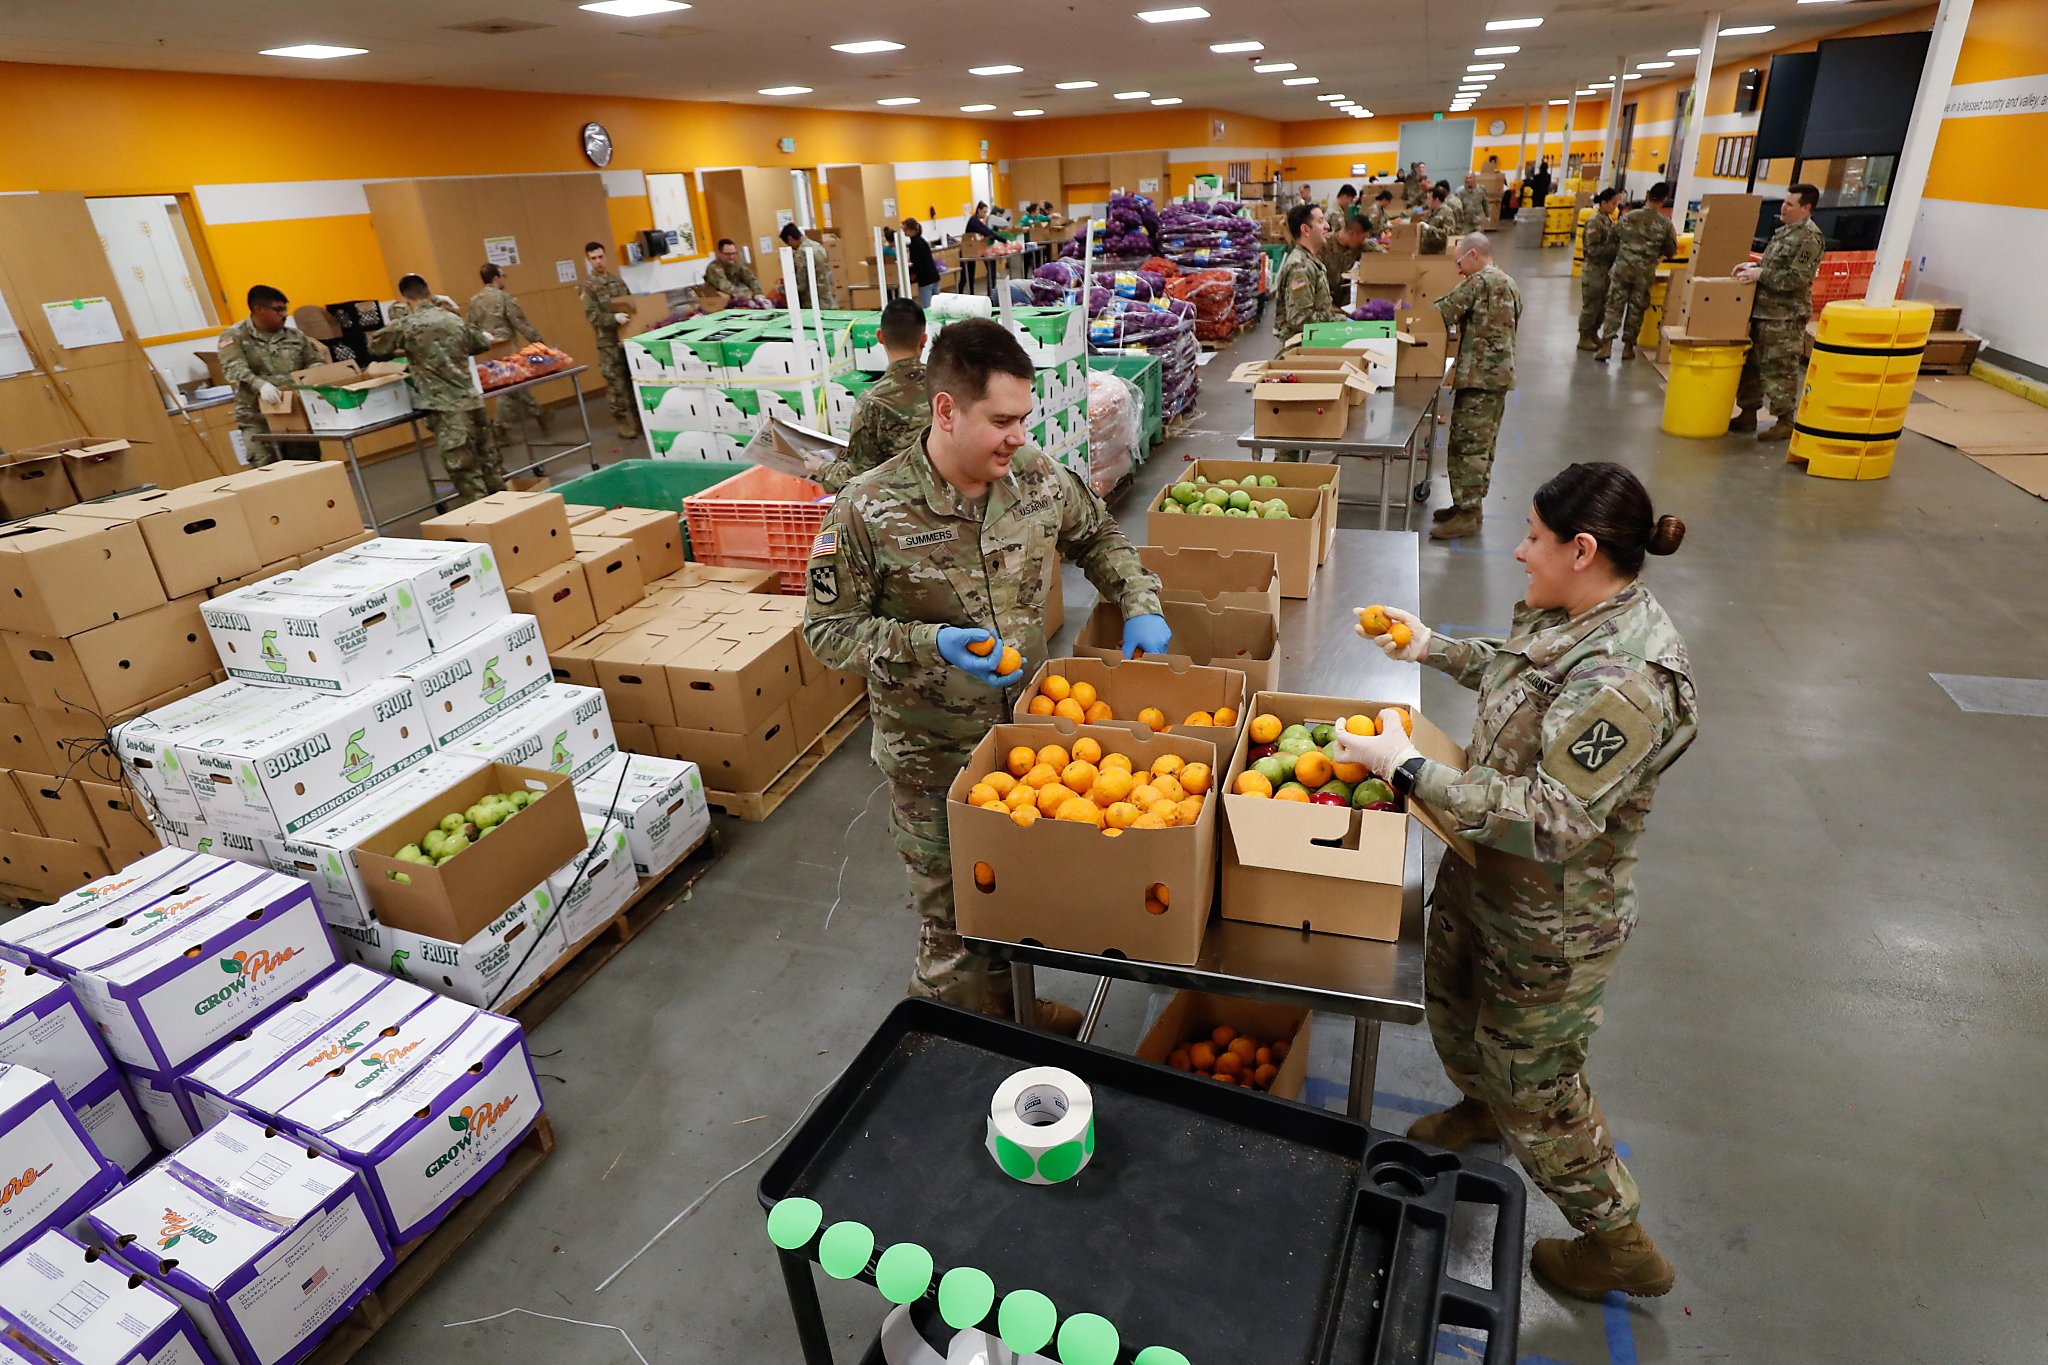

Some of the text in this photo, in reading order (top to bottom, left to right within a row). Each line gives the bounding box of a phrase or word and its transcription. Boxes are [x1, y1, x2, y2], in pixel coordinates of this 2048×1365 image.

[1960, 100, 1984, 112] blessed
[1983, 98, 2006, 112] country
[2005, 95, 2020, 109] and
[906, 530, 952, 545] SUMMERS
[439, 558, 472, 579] Sno-Chief
[349, 593, 388, 617] Sno-Chief
[204, 610, 251, 632] BORTON
[283, 617, 320, 638] FRUIT
[334, 627, 368, 646] UPLAND
[339, 635, 368, 652] PEARS
[421, 623, 535, 697] BORTON FRUIT
[231, 668, 337, 690] WASHINGTON STATE PEARS
[445, 704, 499, 743] WASHINGTON
[498, 690, 524, 711] STATE
[524, 676, 548, 696] PEARS
[572, 695, 603, 725] FRUIT
[264, 689, 414, 779] BORTON FRUIT
[198, 755, 233, 770] Sno-Chief
[293, 749, 429, 830] WASHINGTON STATE PEARS
[131, 892, 211, 937] GROW Pure
[420, 941, 459, 966] FRUIT
[475, 943, 511, 971] UPLAND
[481, 951, 511, 975] PEARS
[194, 947, 305, 1016] GROW Pure
[227, 973, 276, 1008] CITRUS
[354, 1063, 389, 1089] GROW
[382, 1037, 426, 1065] Pure
[425, 1094, 518, 1178] GROW Pure
[454, 1127, 497, 1167] CITRUS
[0, 1163, 53, 1208] ure
[3, 1187, 61, 1233] HAND SELECTED
[184, 1225, 218, 1245] GROW
[245, 1278, 267, 1298] LEMONS
